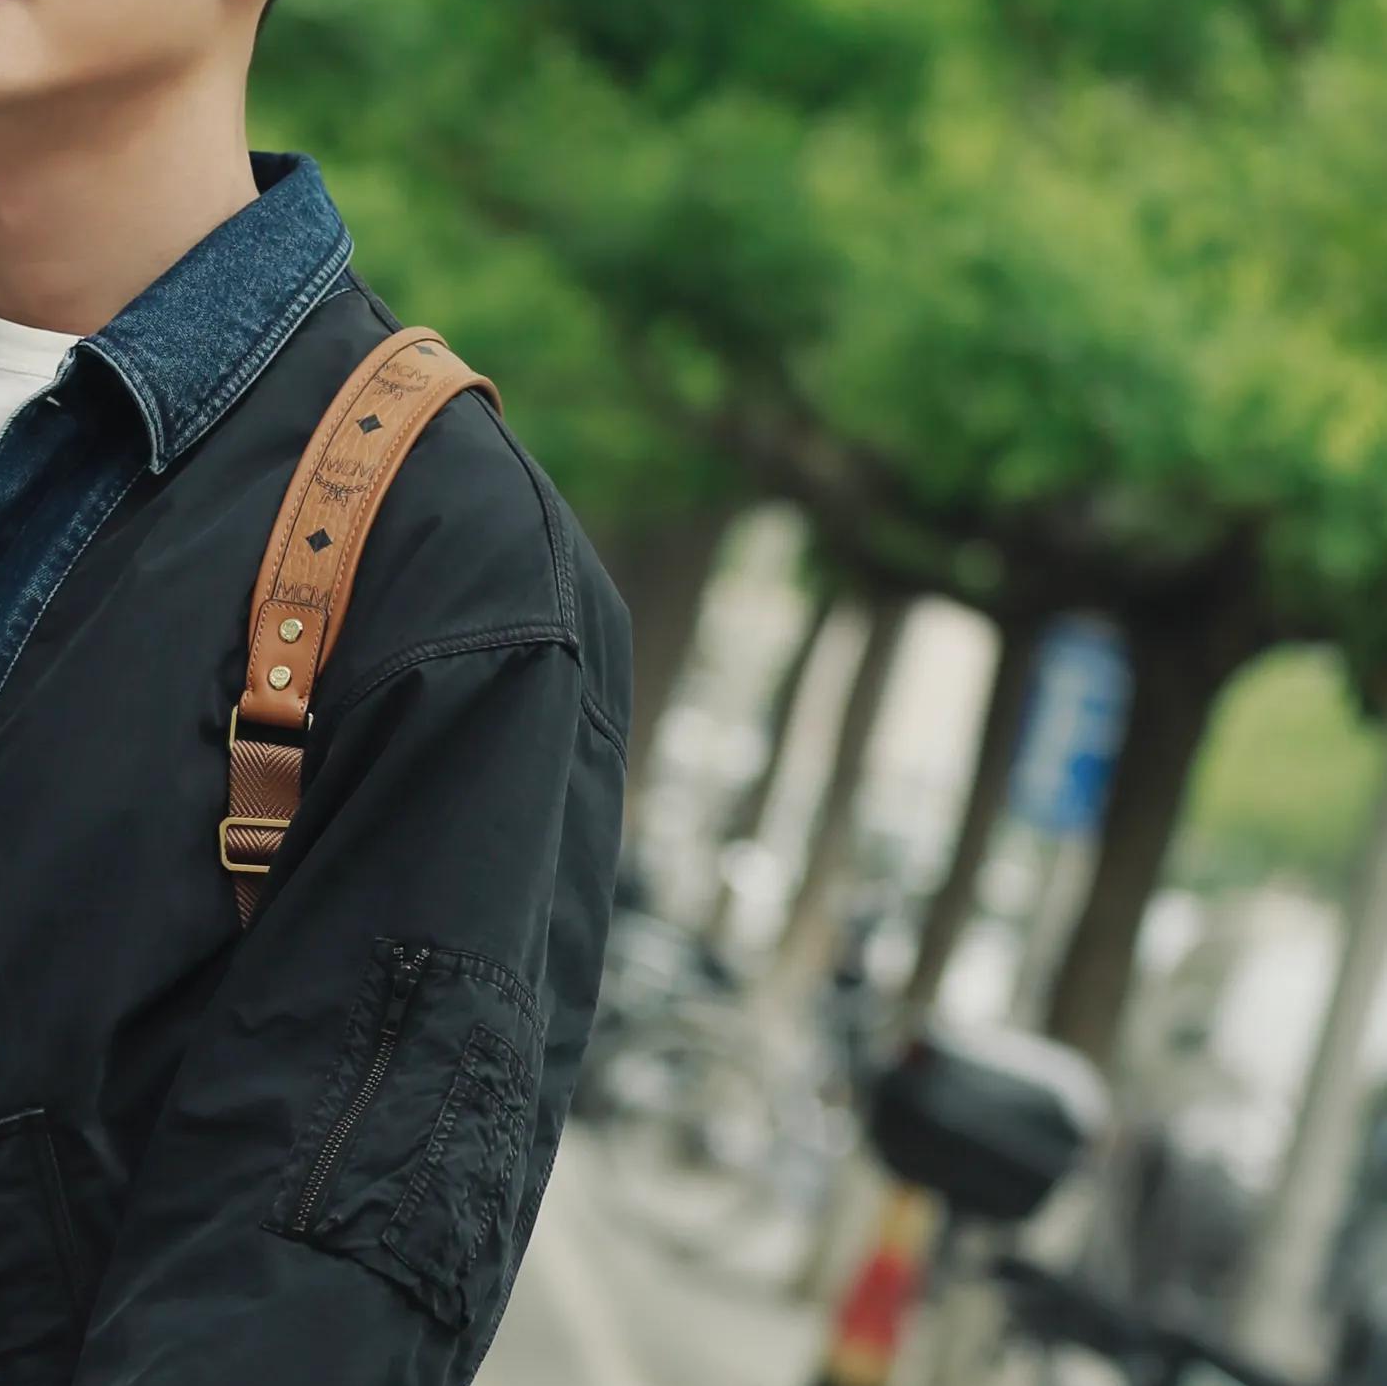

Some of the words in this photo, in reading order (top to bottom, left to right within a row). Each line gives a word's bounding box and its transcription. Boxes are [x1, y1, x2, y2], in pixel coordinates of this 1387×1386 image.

[382, 361, 430, 386] MCM
[320, 455, 375, 480] MCM
[275, 579, 331, 608] MCM
